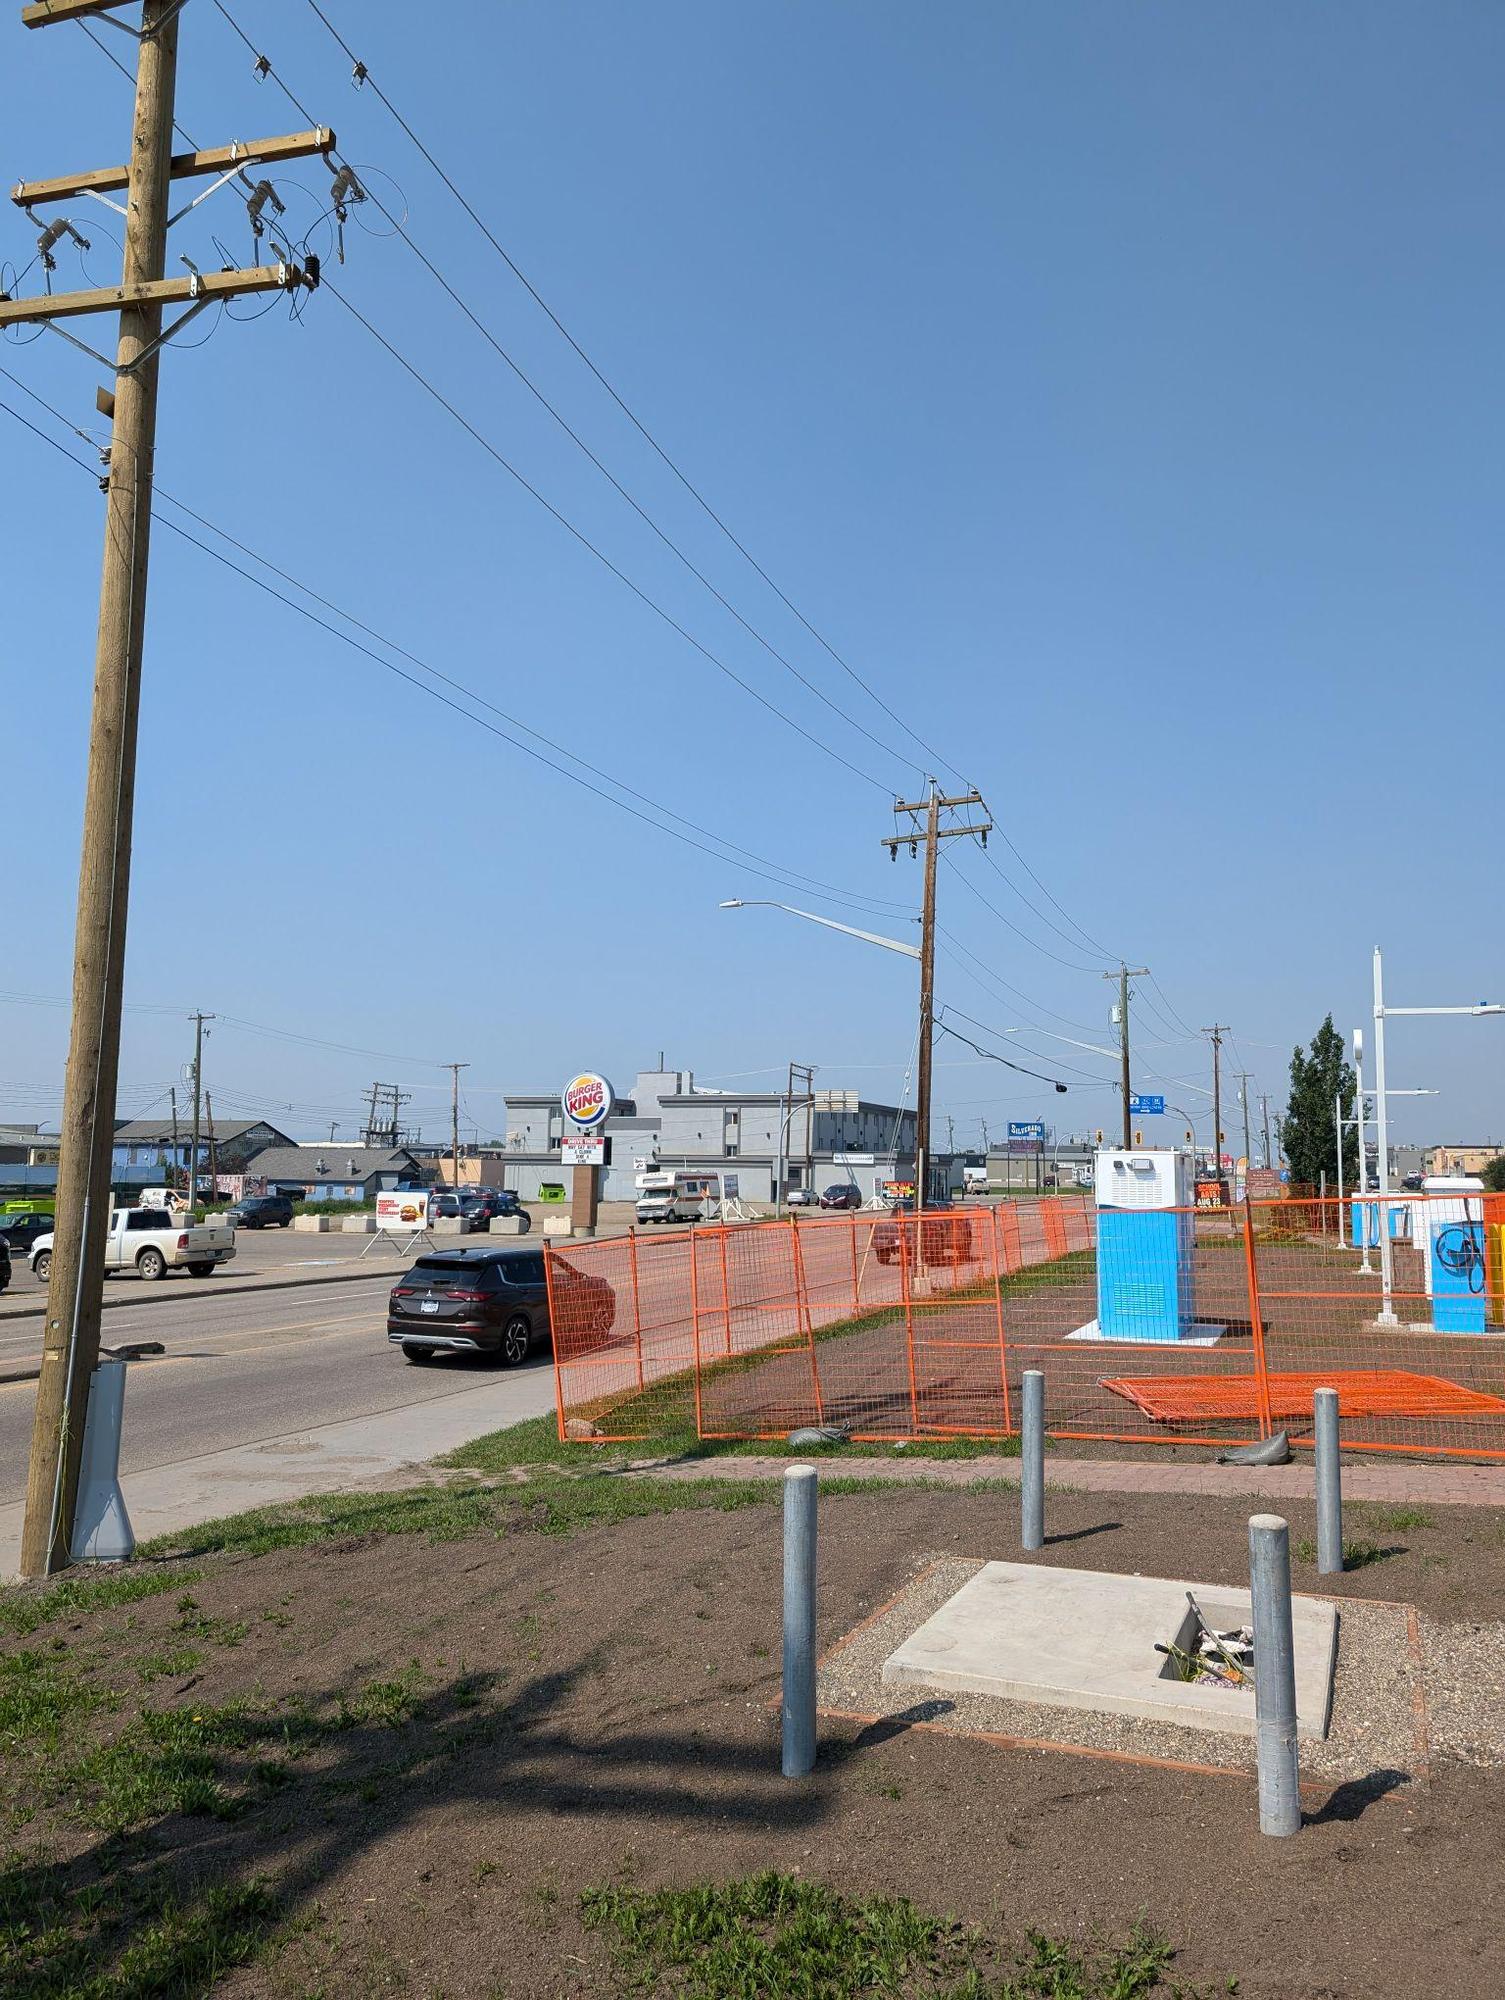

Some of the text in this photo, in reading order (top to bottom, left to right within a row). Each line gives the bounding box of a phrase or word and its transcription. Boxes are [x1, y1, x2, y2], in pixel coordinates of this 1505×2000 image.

[568, 1082, 602, 1101] BURGER
[569, 1091, 603, 1113] KING
[1197, 1198, 1211, 1206] AUG
